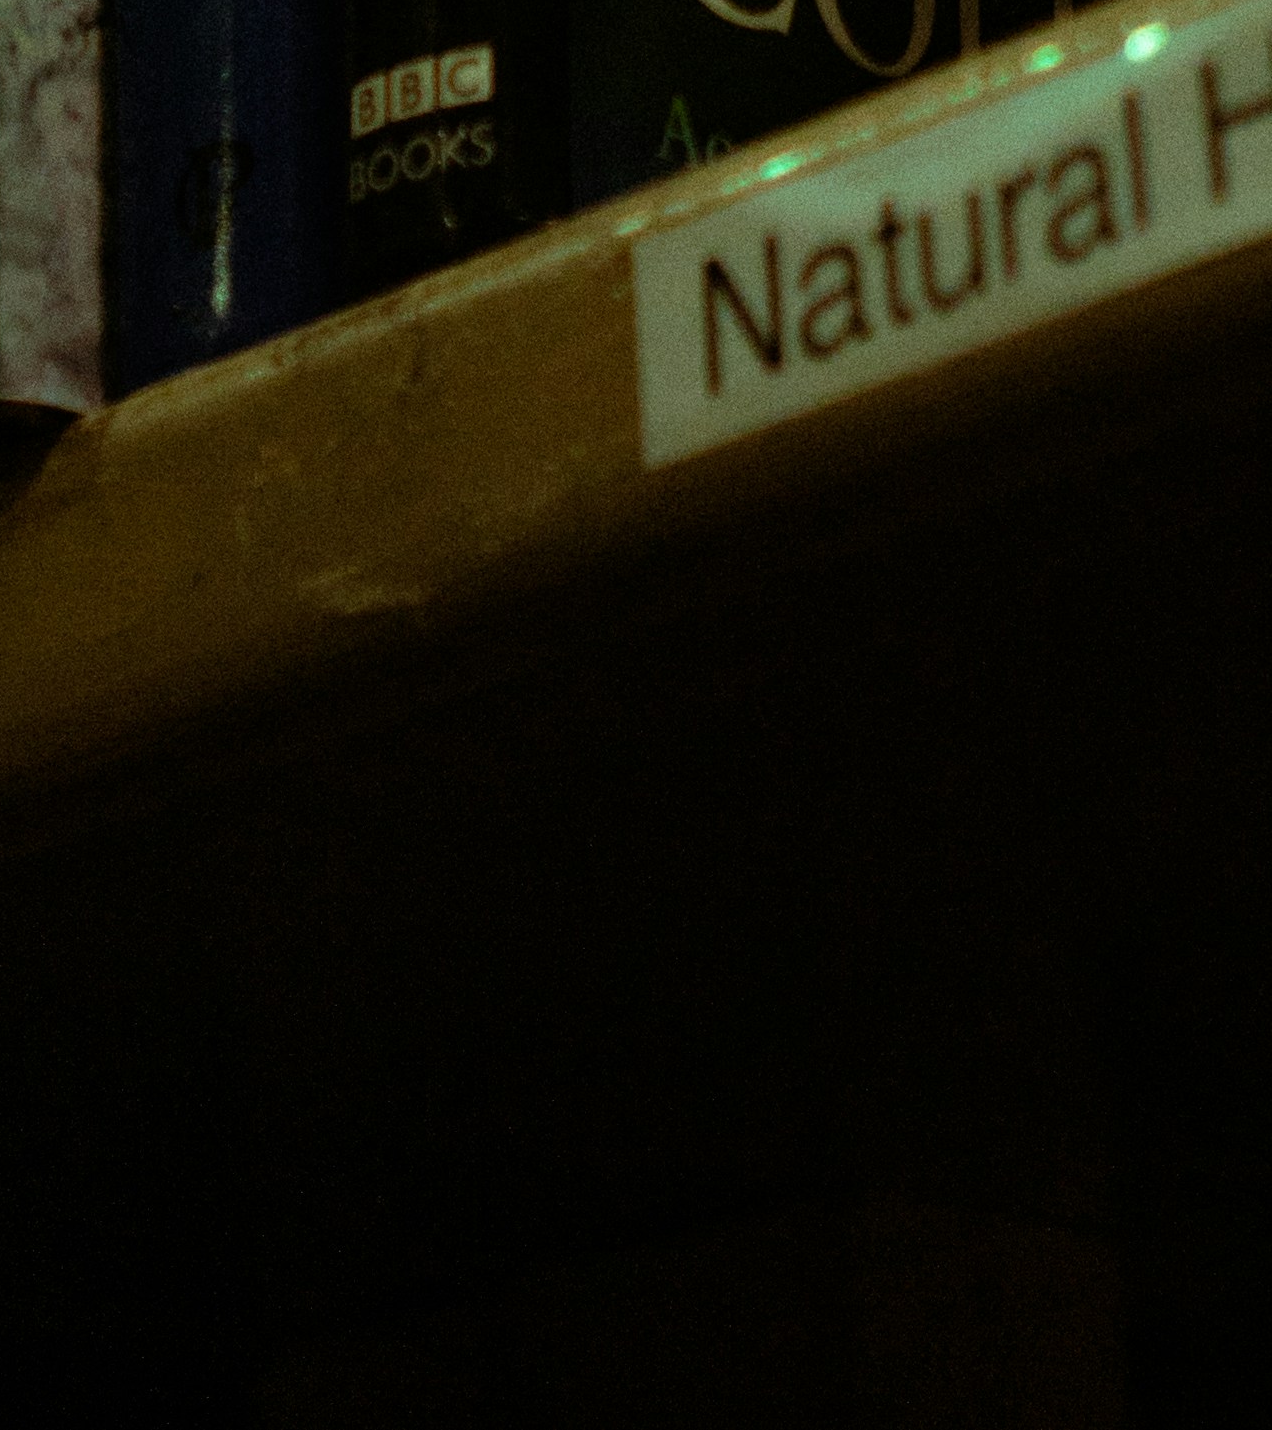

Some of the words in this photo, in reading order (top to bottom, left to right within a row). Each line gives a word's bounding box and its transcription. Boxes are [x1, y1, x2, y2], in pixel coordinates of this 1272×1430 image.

[351, 43, 497, 139] BBC
[347, 121, 495, 207] BOOKS
[695, 117, 1157, 401] Natural
